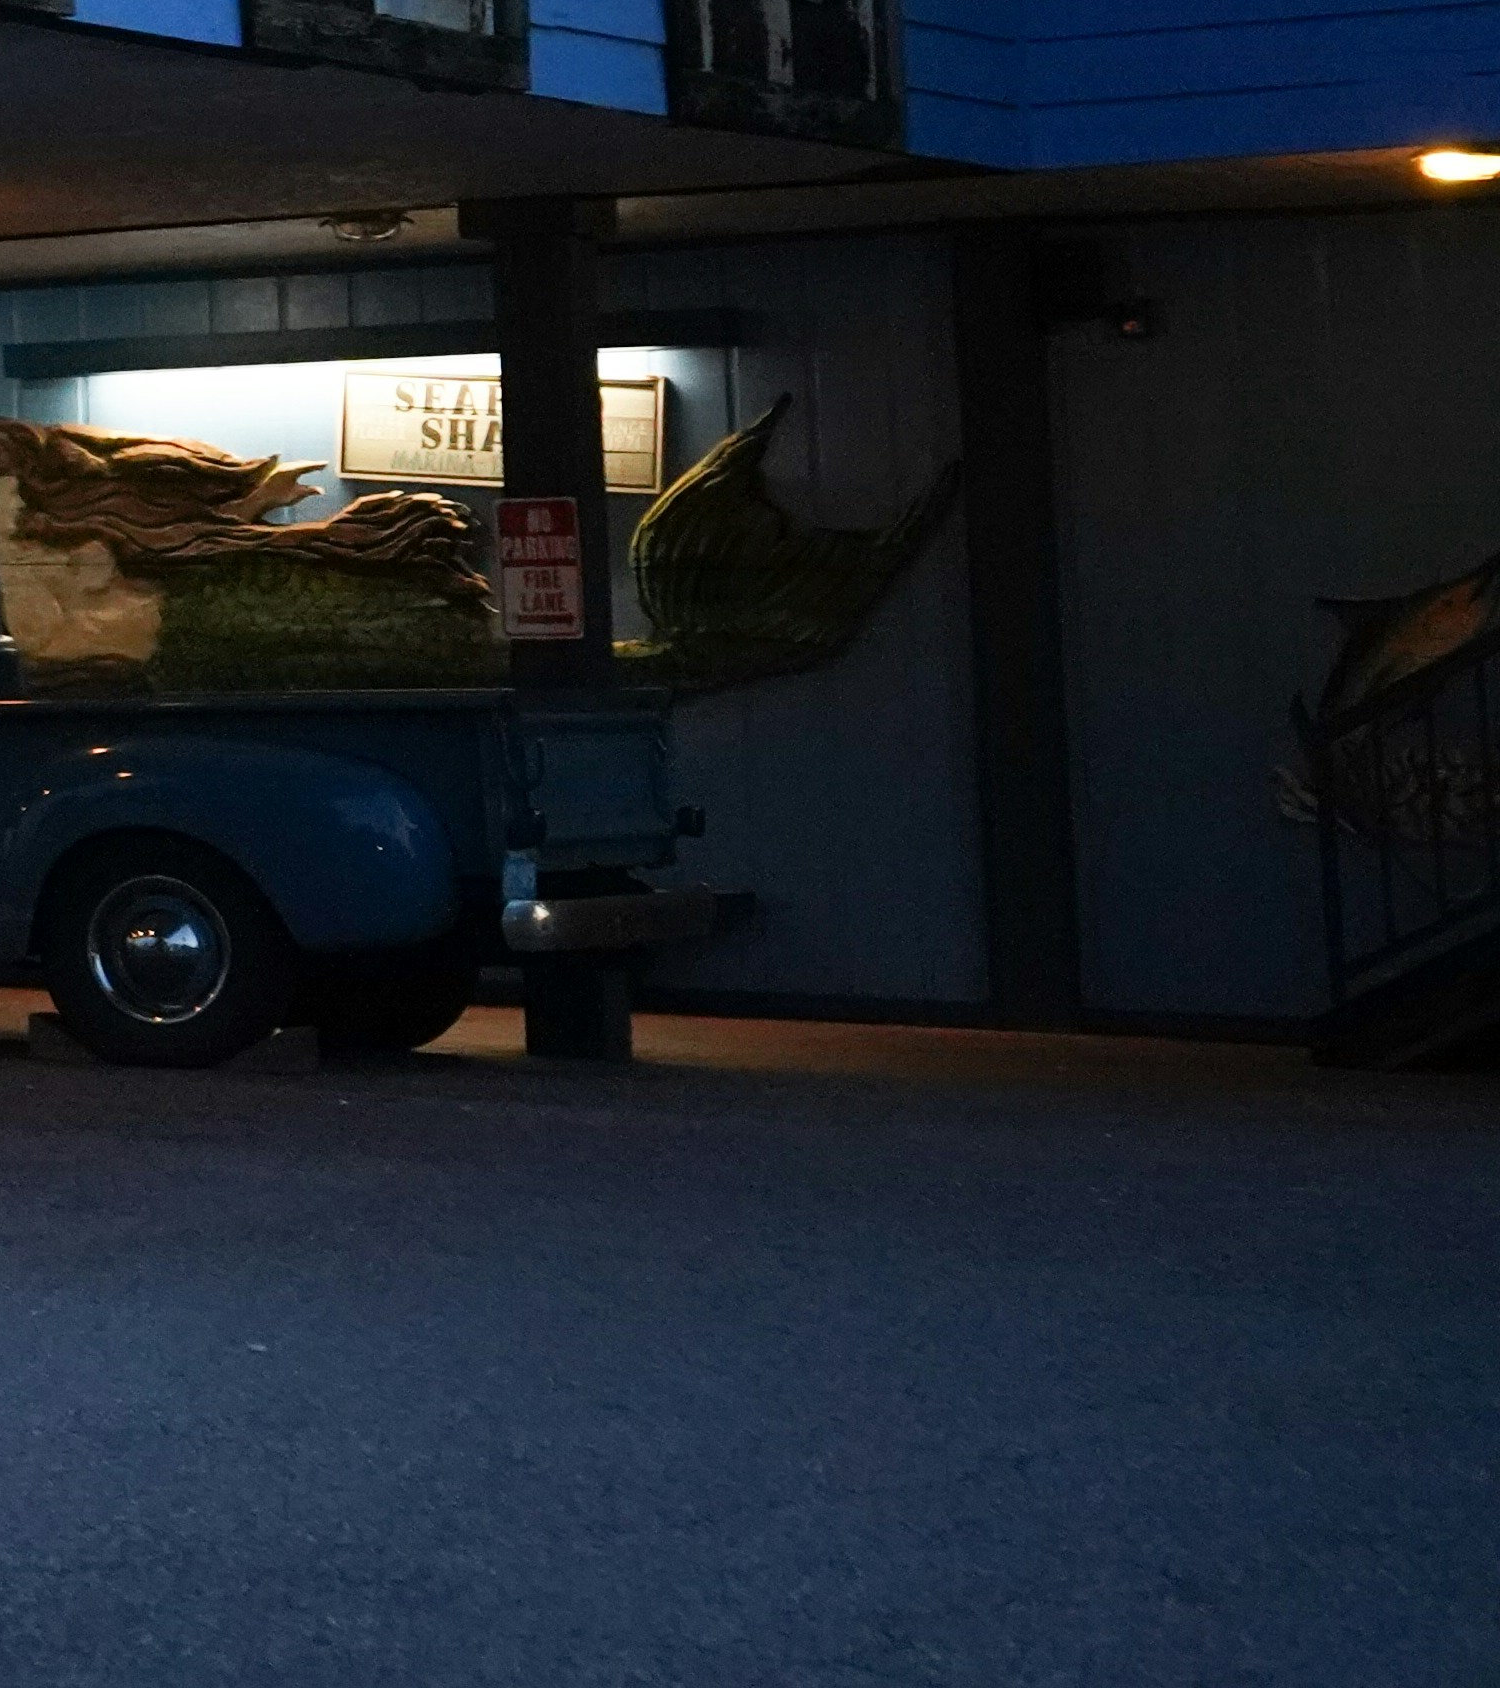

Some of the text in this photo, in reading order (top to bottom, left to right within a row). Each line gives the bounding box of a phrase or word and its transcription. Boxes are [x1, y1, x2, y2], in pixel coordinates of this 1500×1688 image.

[501, 535, 576, 559] PARKING
[522, 569, 562, 589] FIRE
[520, 592, 567, 612] LANE
